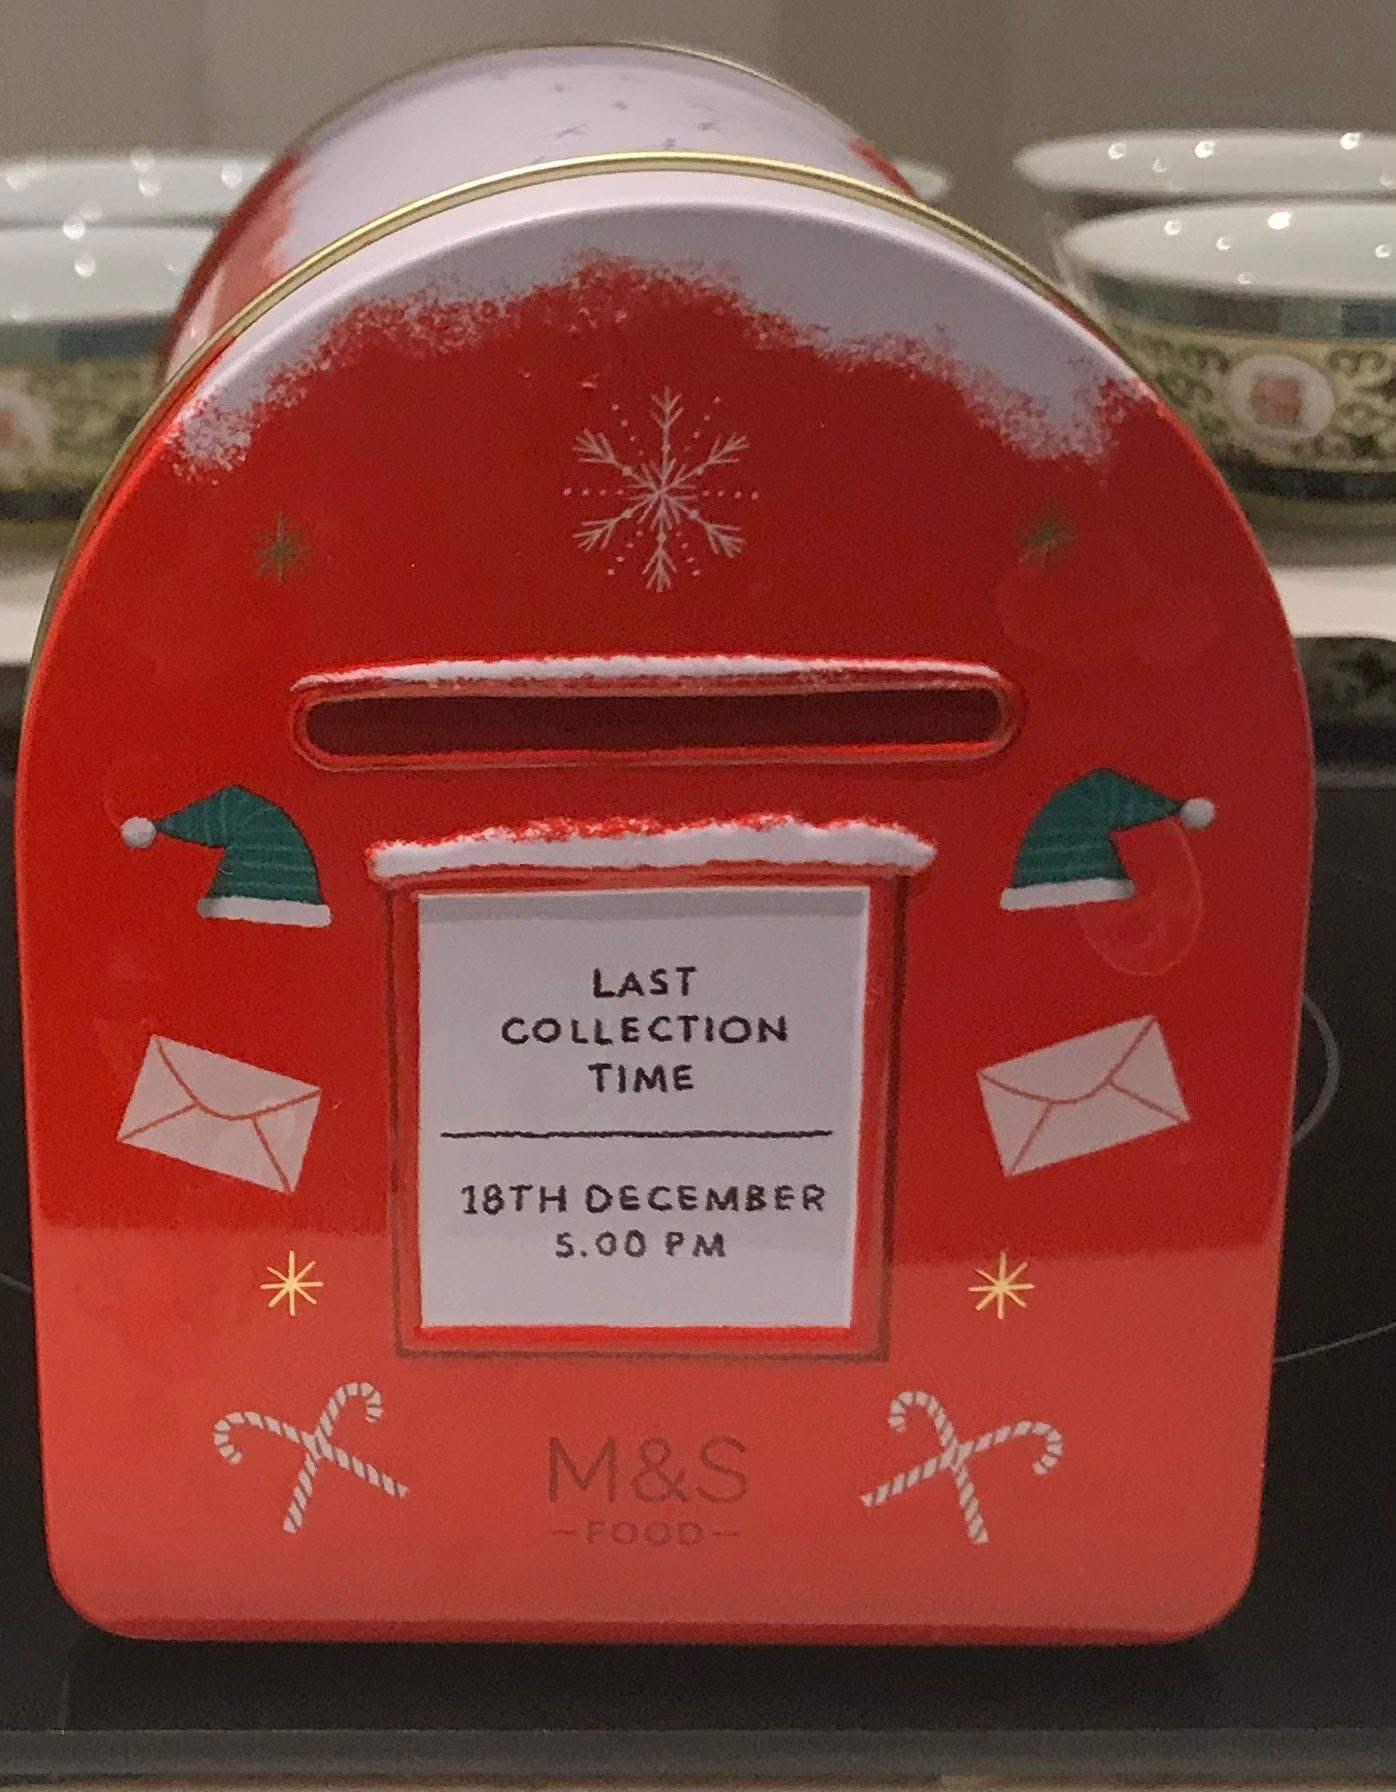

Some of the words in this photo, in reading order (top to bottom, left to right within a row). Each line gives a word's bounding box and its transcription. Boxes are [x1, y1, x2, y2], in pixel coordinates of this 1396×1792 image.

[592, 965, 698, 999] LAST
[501, 1014, 789, 1047] COLLECTION
[587, 1062, 695, 1094] TIME
[459, 1183, 568, 1216] 18TH
[584, 1183, 827, 1214] DECEMBER
[554, 1229, 648, 1259] 5.00
[664, 1230, 727, 1258] PM
[548, 1436, 748, 1504] M&S
[585, 1519, 705, 1547] FOOD
